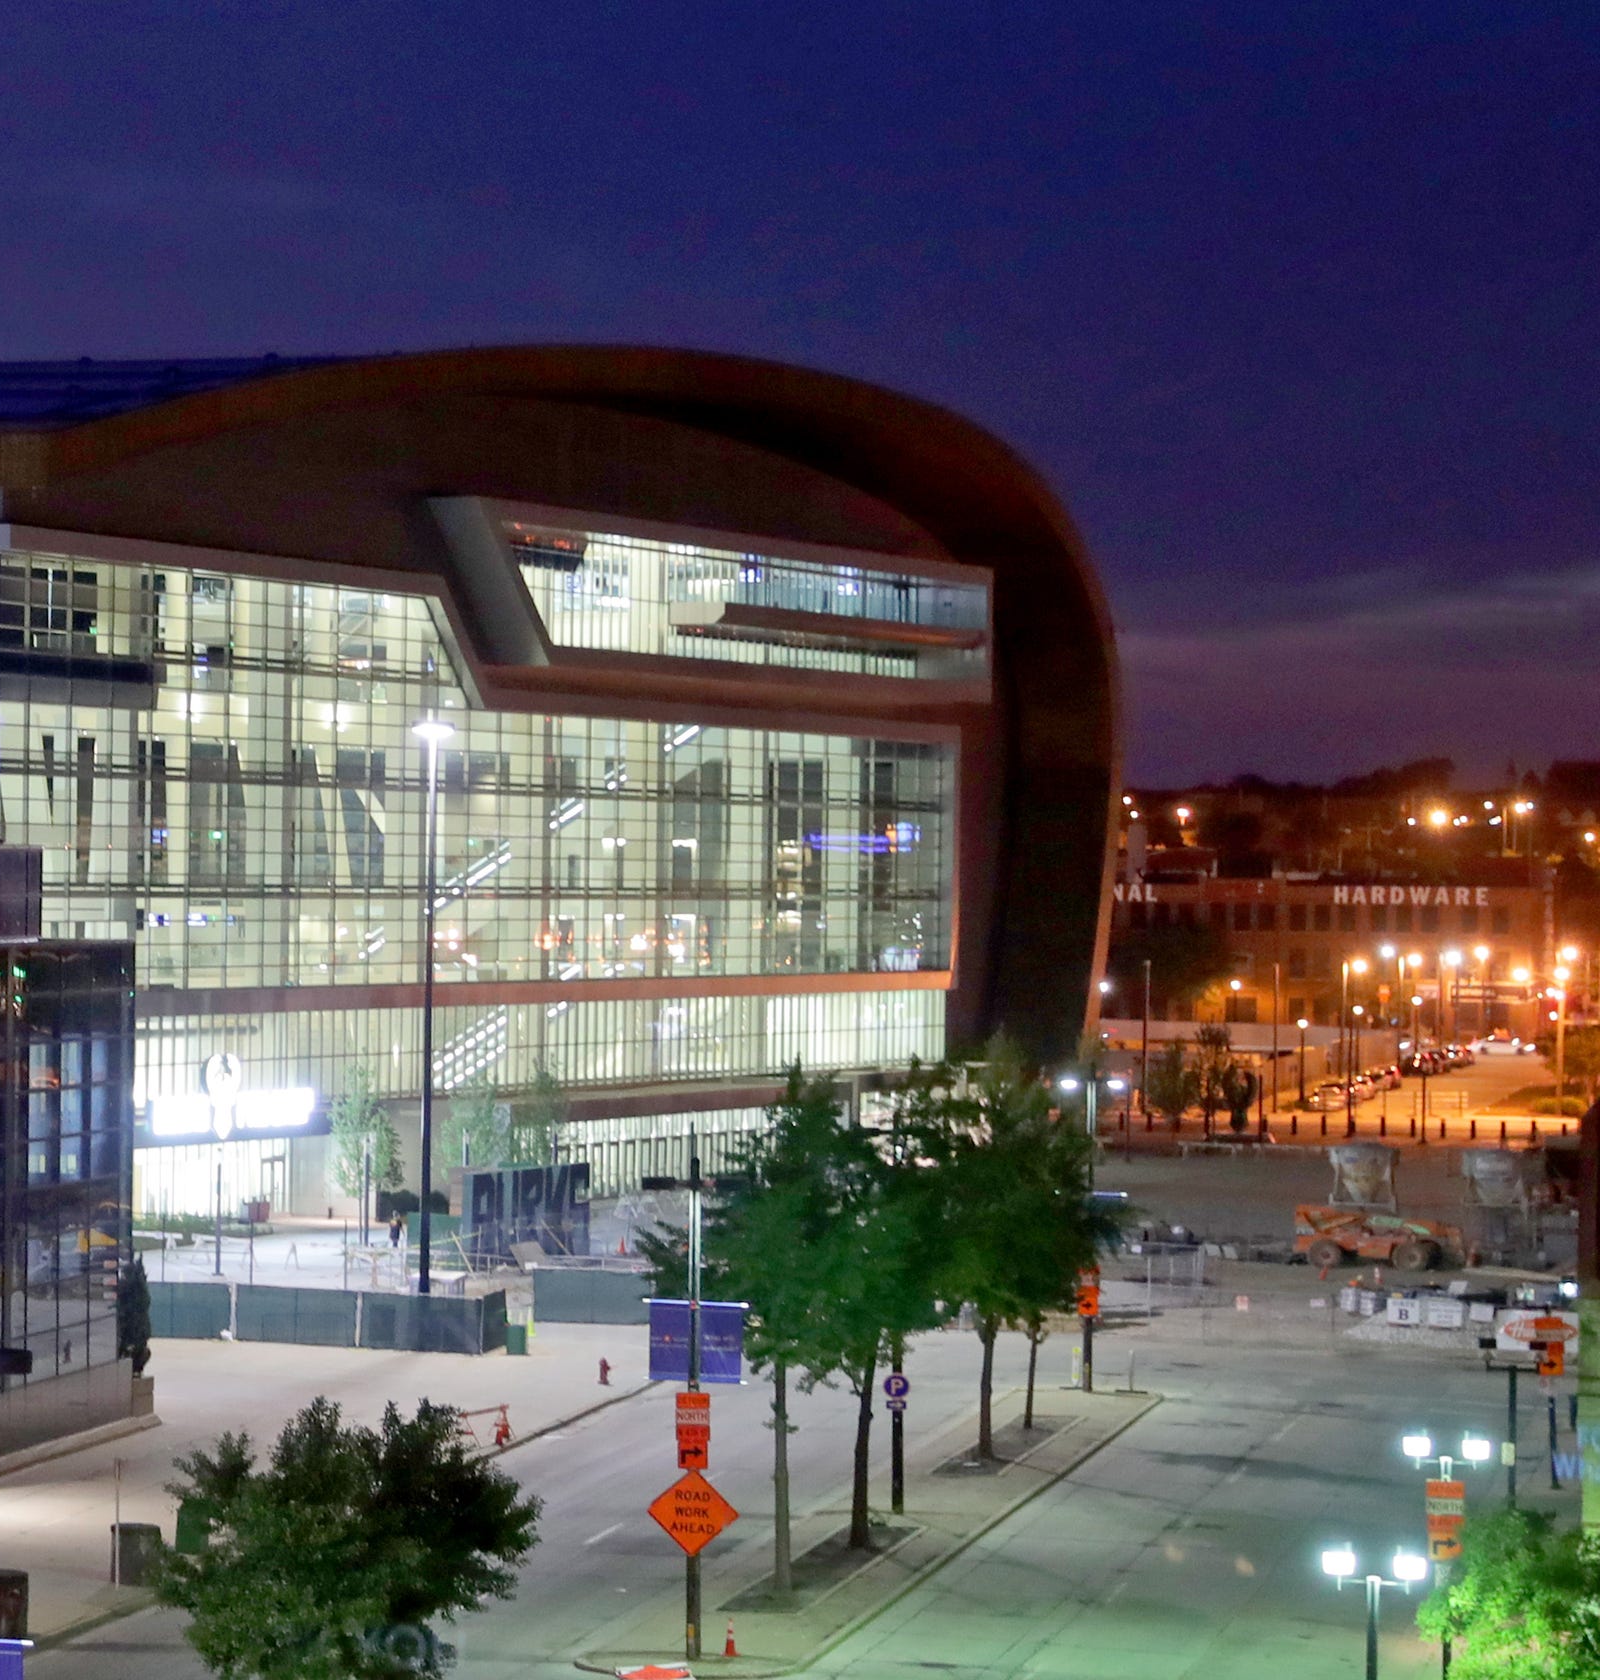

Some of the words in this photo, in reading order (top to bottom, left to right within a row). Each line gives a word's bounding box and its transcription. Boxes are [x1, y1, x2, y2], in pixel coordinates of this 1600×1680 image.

[1333, 886, 1490, 906] HARDWARE
[1398, 1308, 1409, 1321] B
[890, 1378, 905, 1395] P
[677, 1411, 708, 1421] NORTH
[675, 1489, 711, 1502] ROAD
[675, 1506, 710, 1518] WORK
[671, 1521, 715, 1534] AHEAD
